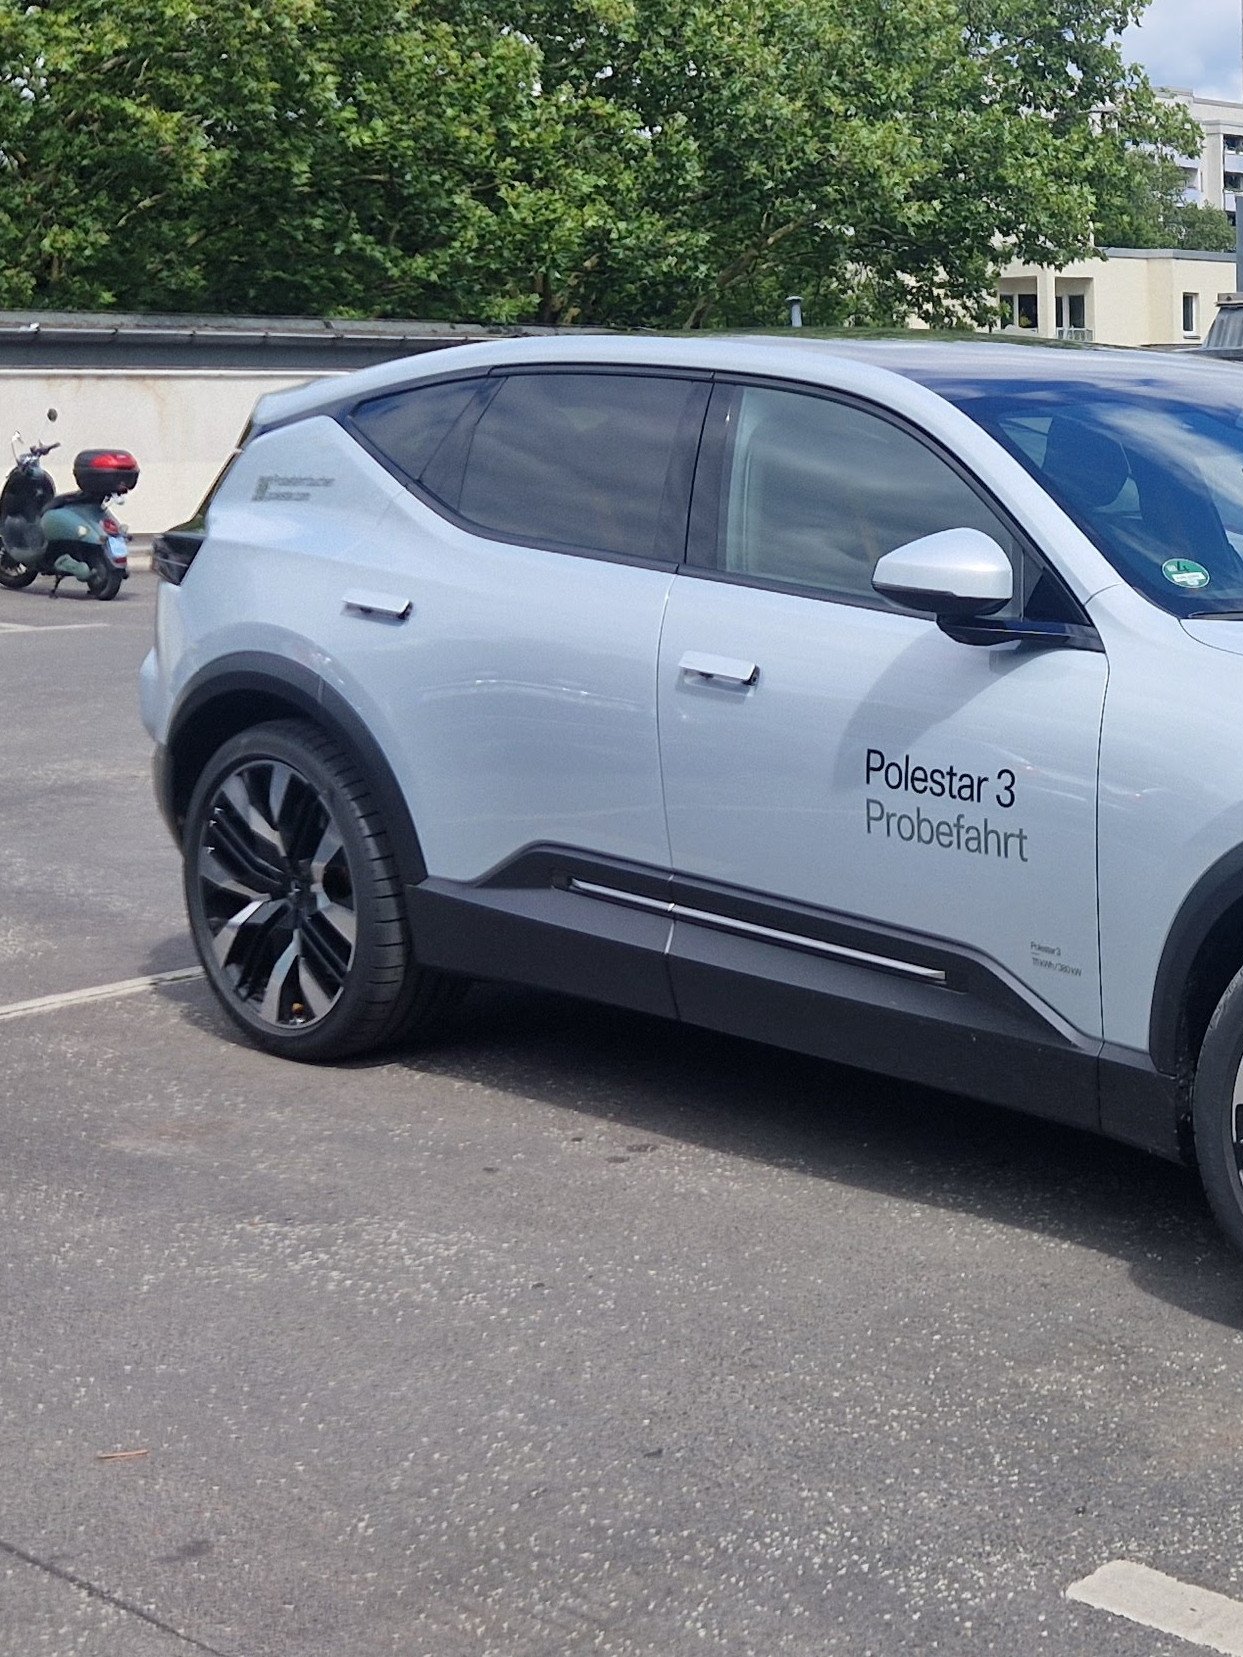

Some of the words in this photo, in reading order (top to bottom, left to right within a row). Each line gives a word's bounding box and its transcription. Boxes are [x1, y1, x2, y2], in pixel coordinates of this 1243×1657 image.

[865, 748, 989, 803] Polestar
[995, 768, 1016, 808] 3
[865, 798, 1028, 862] Probefahrt
